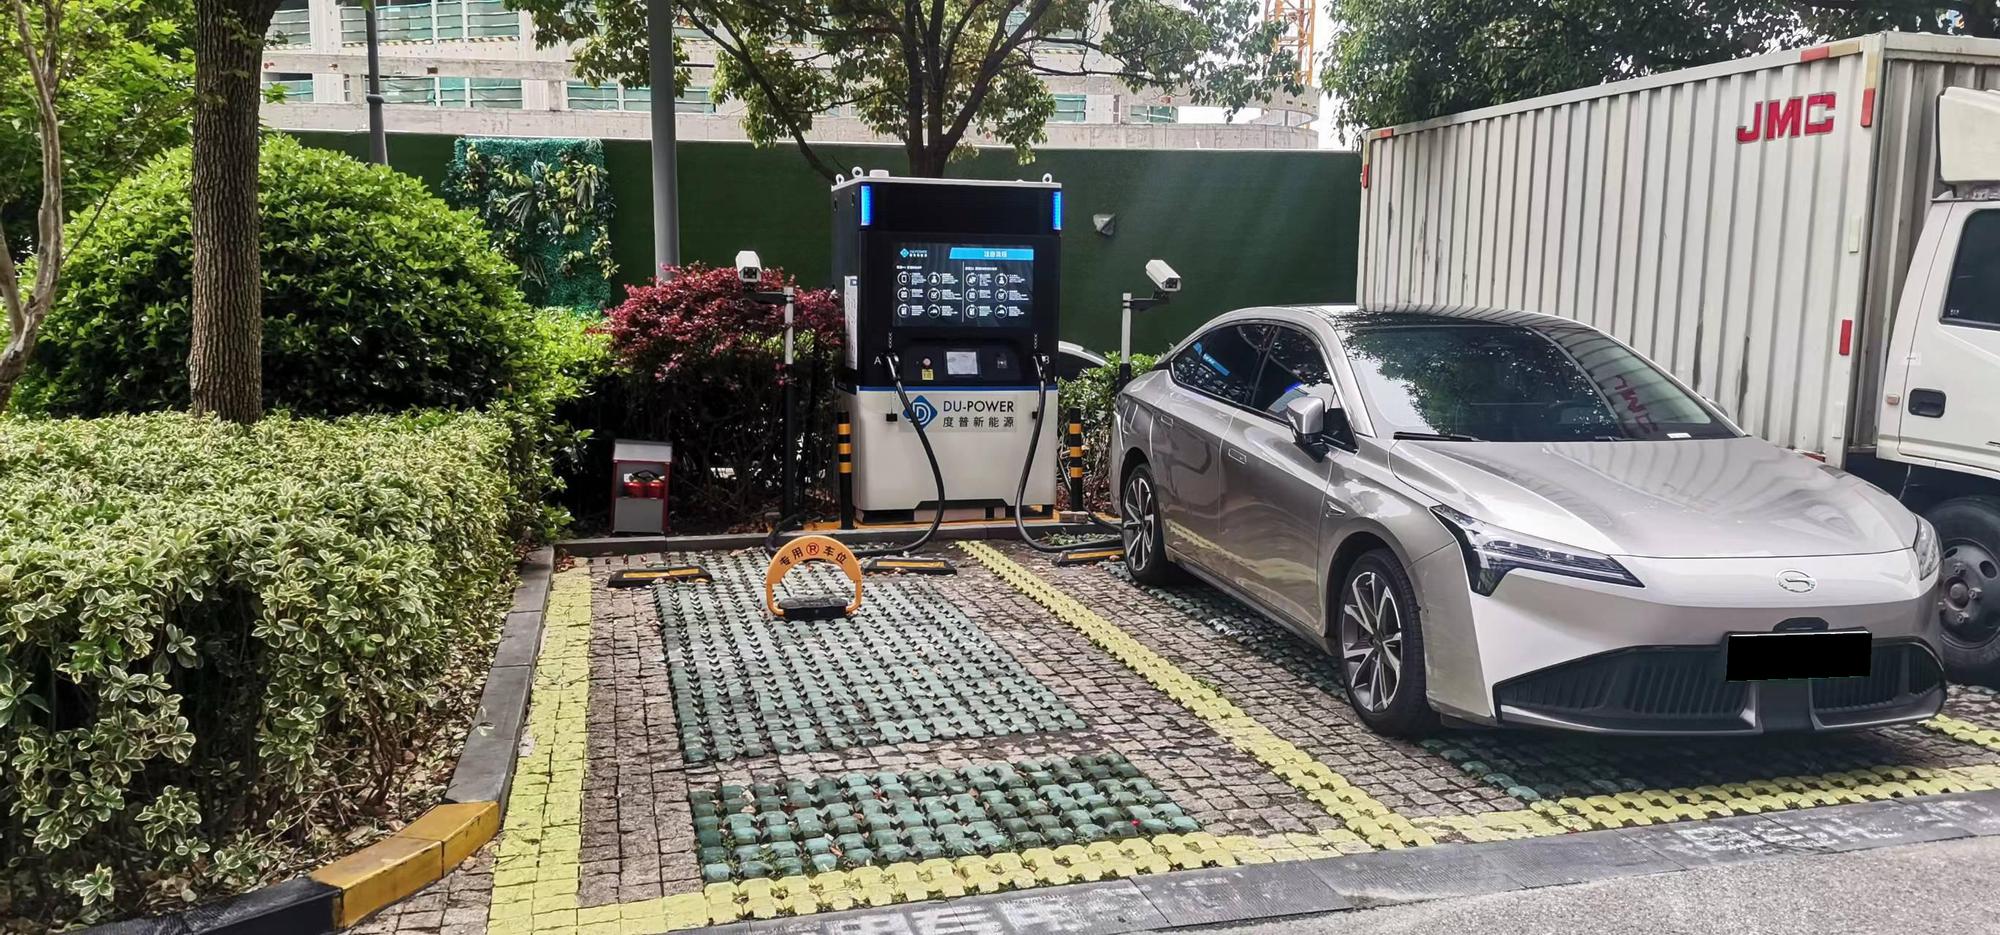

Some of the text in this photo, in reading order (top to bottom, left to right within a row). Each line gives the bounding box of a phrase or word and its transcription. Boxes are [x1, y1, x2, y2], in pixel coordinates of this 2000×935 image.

[1736, 91, 1837, 144] JMC
[873, 356, 882, 365] A
[943, 400, 1014, 413] DU-POWER
[943, 416, 1014, 428] 度普新能源
